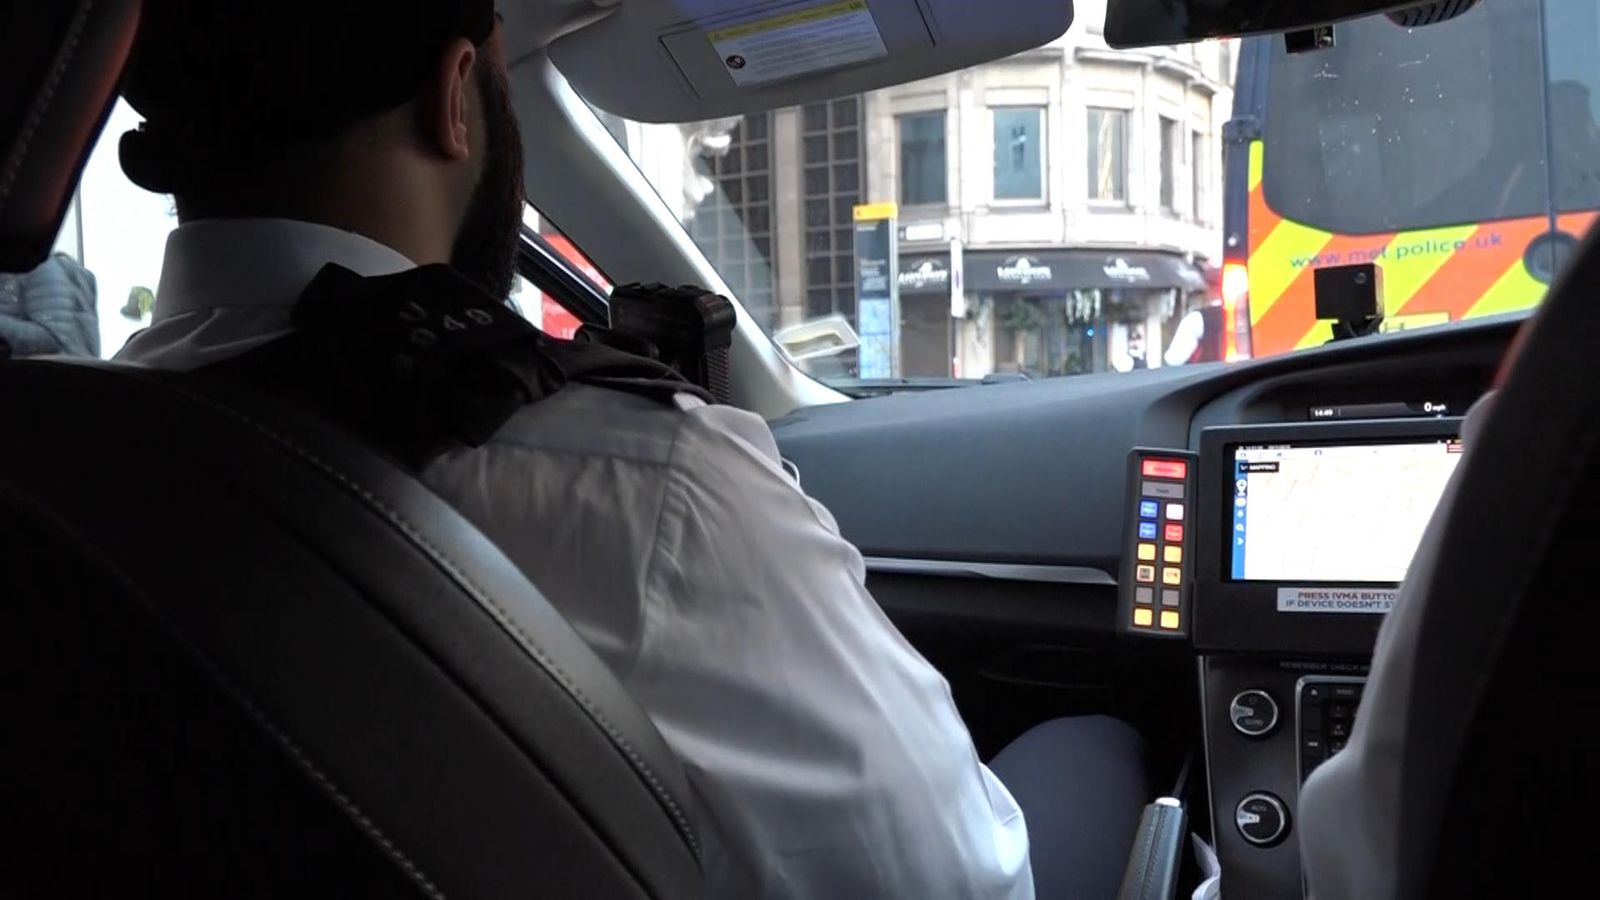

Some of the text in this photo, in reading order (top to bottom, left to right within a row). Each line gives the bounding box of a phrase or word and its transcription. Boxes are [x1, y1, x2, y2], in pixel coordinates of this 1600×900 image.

[1297, 592, 1397, 601] PRESS IVMA BUTTO
[1286, 600, 1295, 608] IF
[1297, 600, 1334, 608] DEVICE
[1336, 600, 1381, 609] DOESN'T
